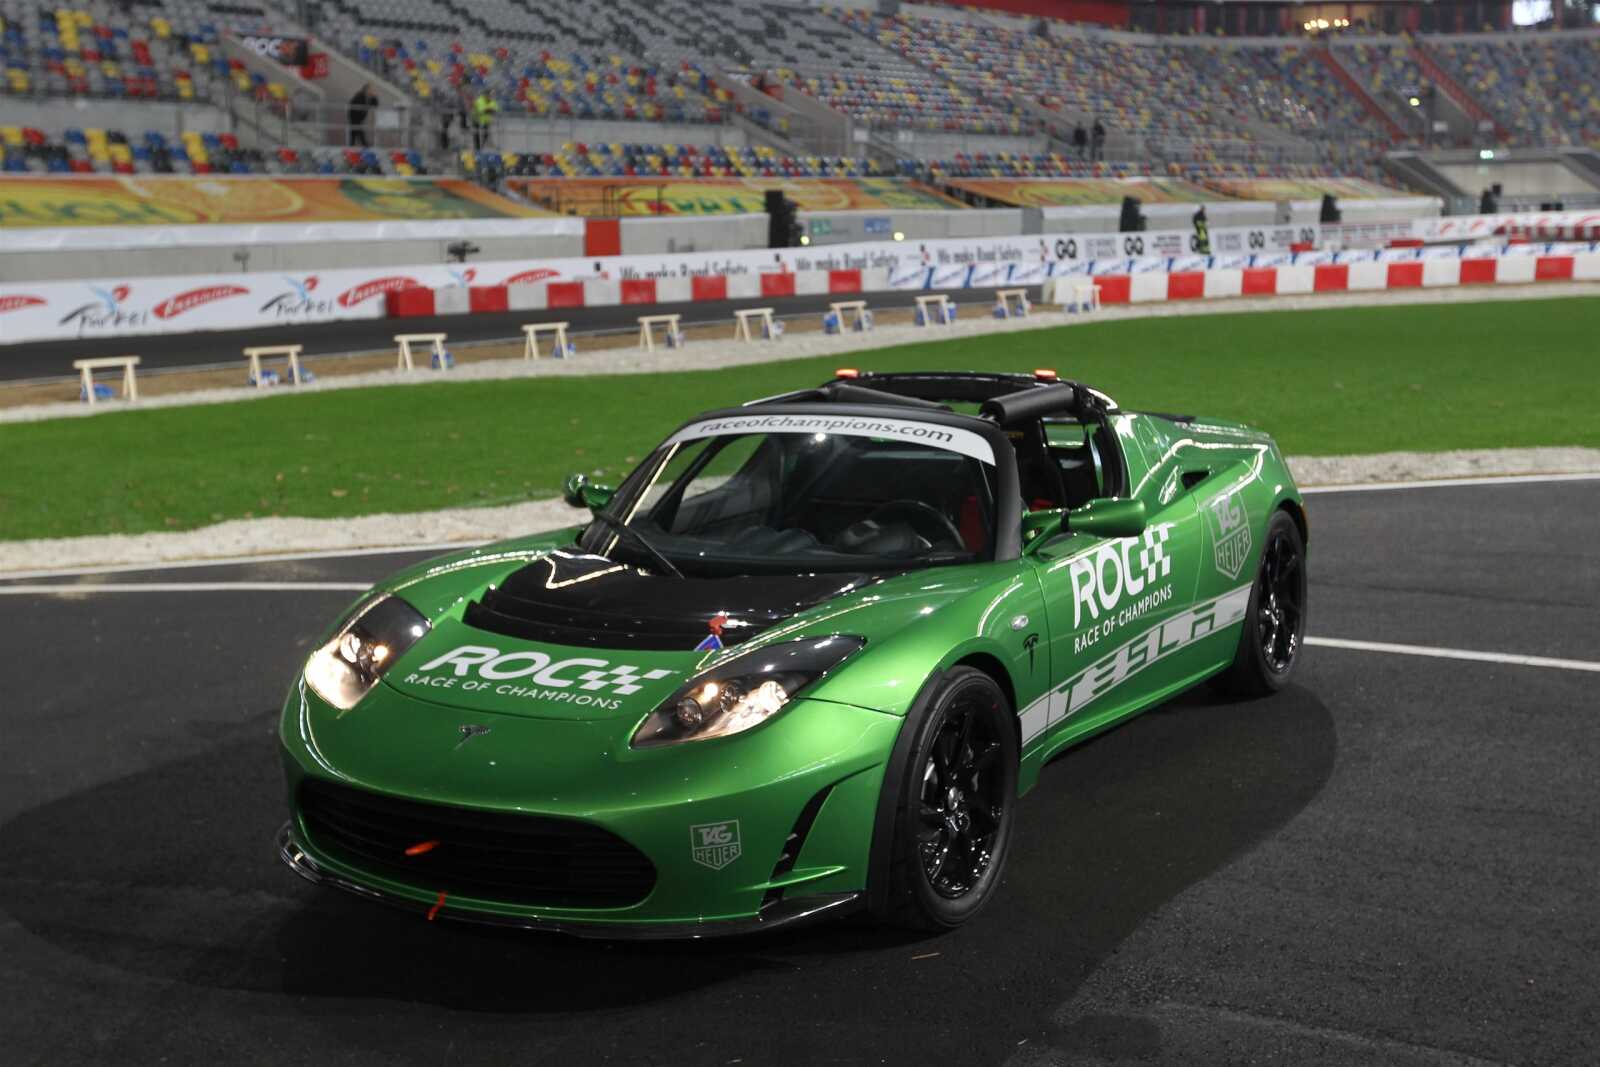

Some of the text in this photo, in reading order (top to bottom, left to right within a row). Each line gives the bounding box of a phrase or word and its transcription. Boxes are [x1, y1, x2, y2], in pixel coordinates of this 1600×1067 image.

[1055, 239, 1077, 259] GQ
[1124, 235, 1144, 255] GQ
[1248, 229, 1265, 249] GQ
[700, 416, 954, 443] raceofchampions.com
[1211, 496, 1241, 535] TAG
[1216, 532, 1250, 574] HEUER
[1069, 536, 1145, 630] ROC
[1074, 583, 1173, 655] RACE OF CHAMPIONS
[419, 645, 609, 687] ROC
[1057, 602, 1216, 716] TESLA
[404, 673, 624, 711] RACE OF CHAMPIONS
[698, 825, 733, 846] TAG
[696, 846, 738, 867] HEUER
